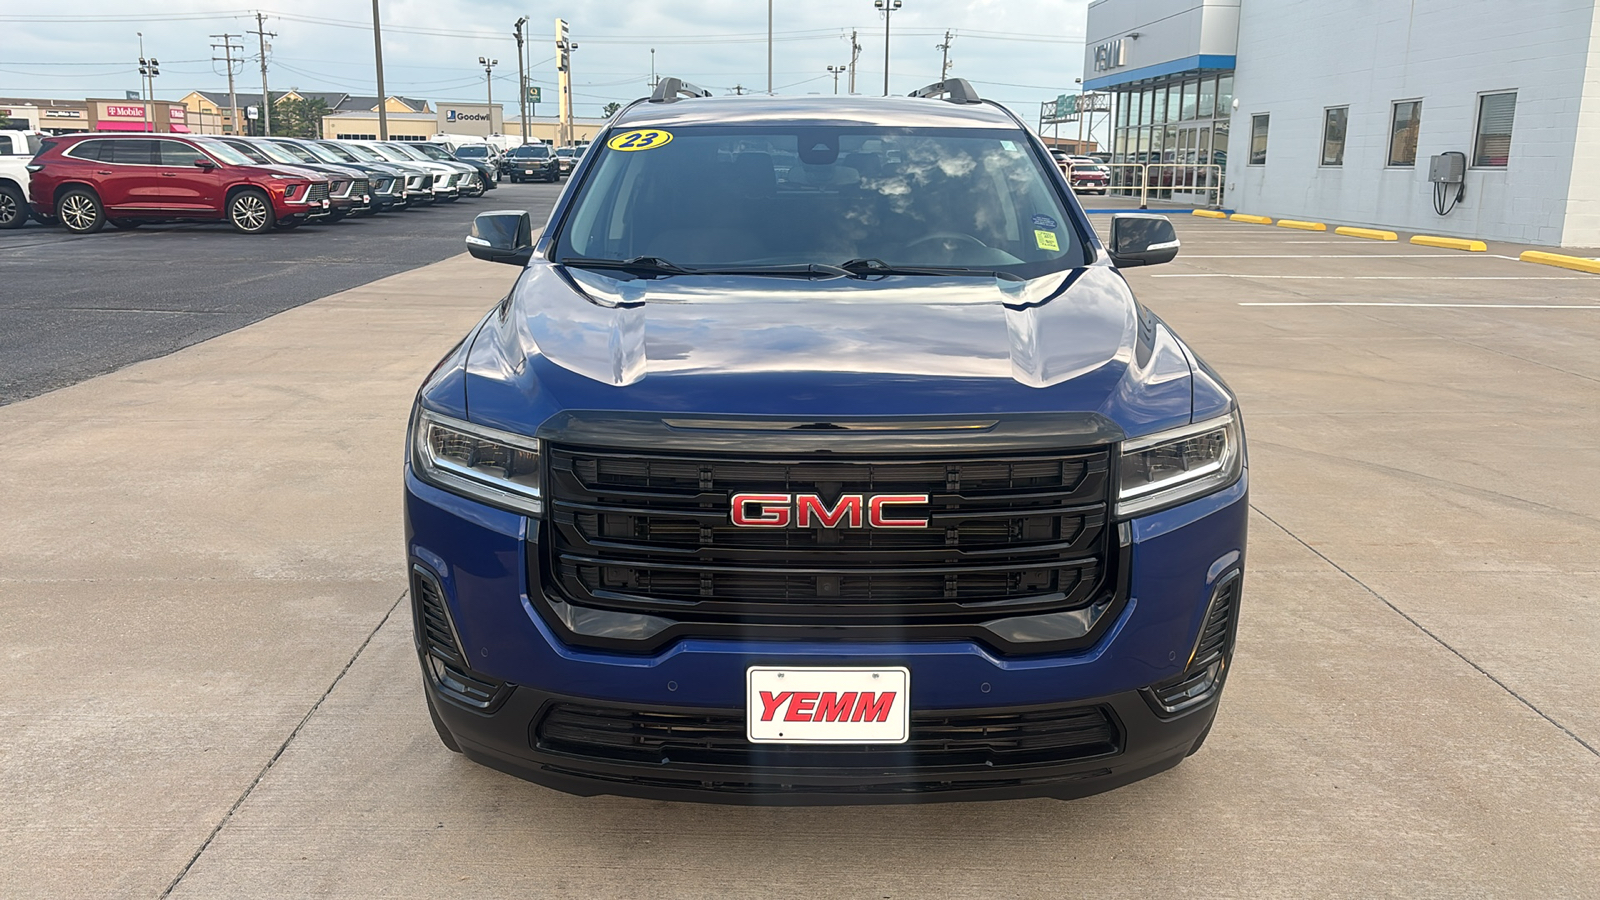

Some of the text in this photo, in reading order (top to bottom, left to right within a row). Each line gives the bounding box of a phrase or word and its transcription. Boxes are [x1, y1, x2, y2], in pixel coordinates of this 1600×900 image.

[117, 108, 143, 116] Mobile
[457, 112, 491, 121] Goodwil
[619, 132, 659, 148] 23
[731, 494, 929, 528] GMC
[759, 691, 897, 722] YEMM
